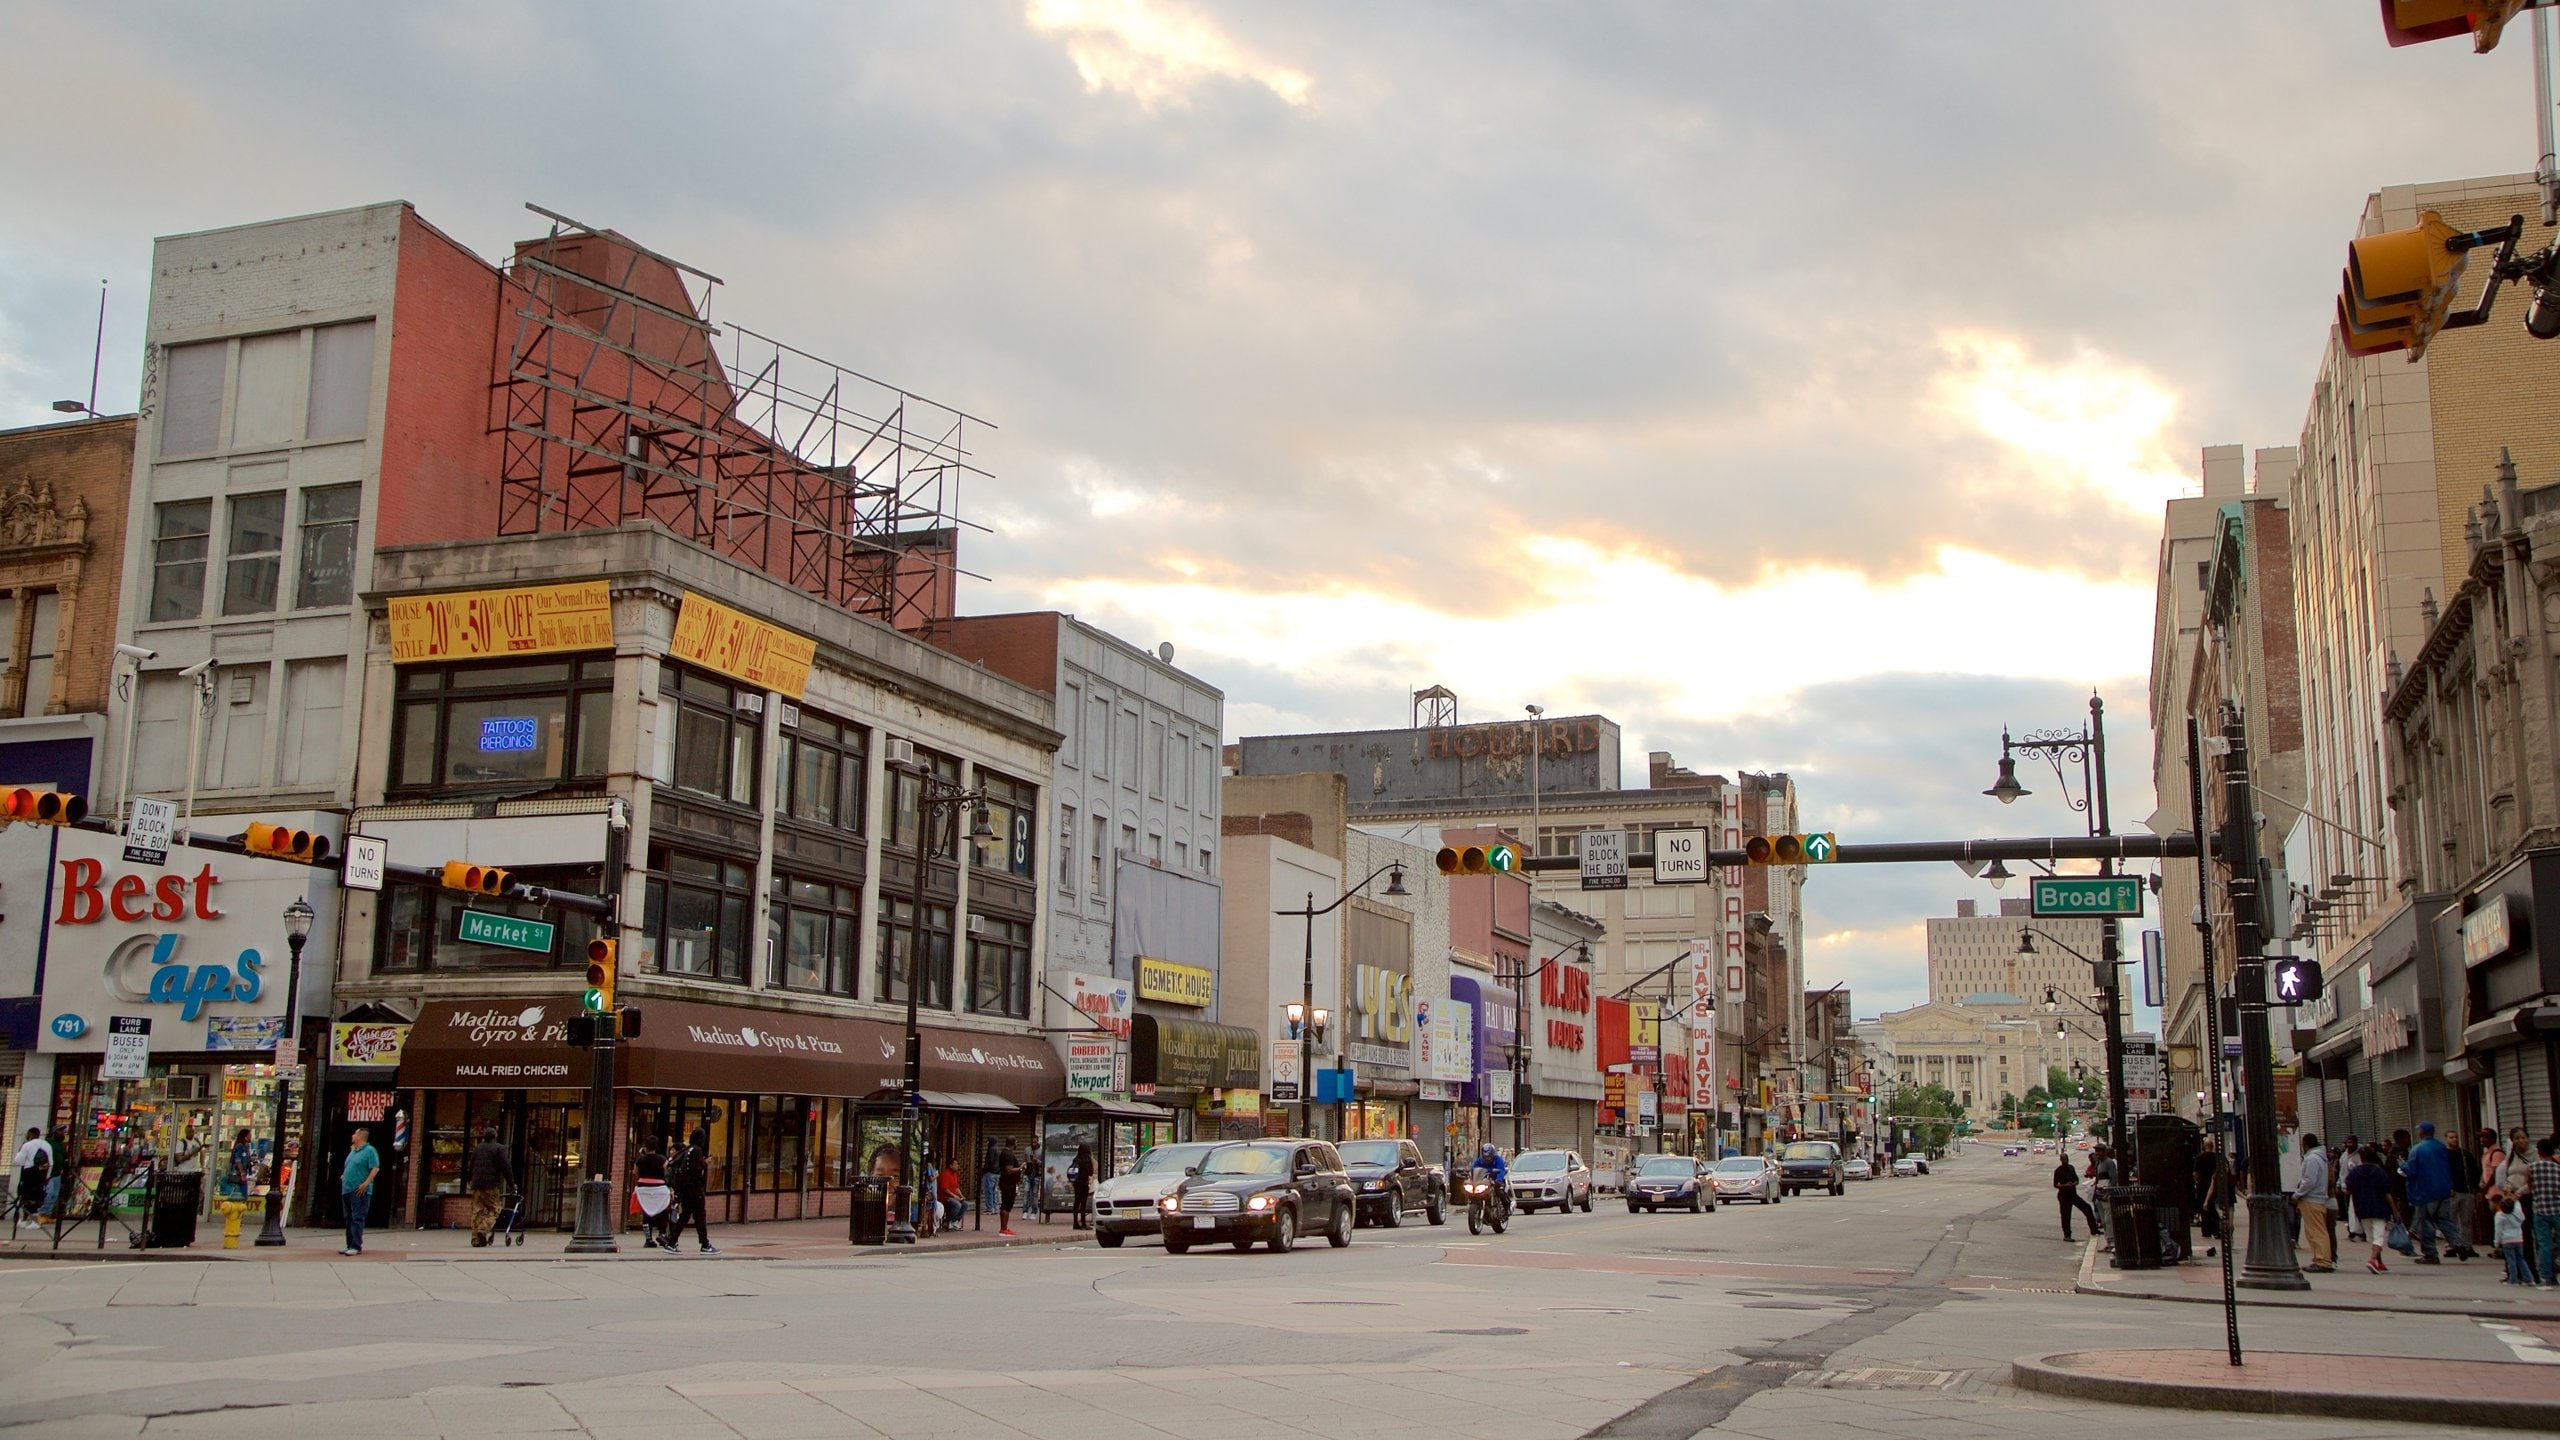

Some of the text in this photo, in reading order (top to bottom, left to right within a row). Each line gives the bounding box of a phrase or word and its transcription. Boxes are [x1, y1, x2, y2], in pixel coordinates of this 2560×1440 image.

[536, 588, 608, 609] Our Normal Prices
[391, 602, 421, 621] HOUSE
[504, 594, 533, 639] OFF
[683, 597, 705, 621] HOUSE
[401, 623, 410, 636] OF
[394, 640, 425, 658] STYLE
[673, 633, 697, 659] STYLE
[749, 626, 774, 669] OFF
[480, 734, 534, 750] PIERCINGS
[142, 802, 168, 818] DON'T
[137, 818, 166, 834] BLOCK
[130, 832, 169, 850] THE BOX
[1590, 834, 1617, 847] DON'T
[1670, 838, 1691, 853] NO
[358, 847, 375, 862] NO
[1588, 849, 1619, 861] BLOCK
[350, 866, 379, 881] TURNS
[1584, 862, 1625, 876] THE BOX
[1660, 860, 1702, 873] TURNS
[55, 858, 220, 926] Best
[2041, 886, 2131, 907] Broad St
[469, 918, 544, 943] Market St
[1692, 942, 1710, 955] DR.
[1143, 967, 1211, 999] COSMETIC HOUSE
[1356, 963, 1414, 1043] YES
[120, 1017, 142, 1026] CURB
[448, 1009, 520, 1027] Madina
[57, 1020, 80, 1033] 791
[119, 1026, 142, 1034] LANE
[1694, 1028, 1712, 1040] DR.
[112, 1036, 144, 1047] BUSES
[470, 1026, 518, 1047] Gyro
[520, 1025, 538, 1041] &
[687, 1025, 843, 1054] Madina Gyro & Pizza
[1547, 1019, 1584, 1051] LADIES
[282, 1040, 294, 1048] NO
[1071, 1045, 1111, 1056] ROBERTO'S
[1163, 1040, 1220, 1059] COSMETIC HOUSE
[1421, 1032, 1430, 1063] GAMES
[935, 1046, 1044, 1070] Madina Gyro & Pizza
[1226, 1048, 1259, 1081] JEWELRY
[2122, 1057, 2151, 1065] BUSES
[456, 1065, 569, 1076] HALAL FRIED CHICKEN
[1193, 1060, 1212, 1077] Supply
[226, 1079, 248, 1097] ATM
[880, 1078, 896, 1087] HALAL
[1070, 1072, 1111, 1091] Newport
[2159, 1062, 2169, 1099] PARK
[1135, 1083, 1155, 1096] ATM
[348, 1091, 394, 1107] BARBER
[348, 1107, 385, 1121] TATTOOS
